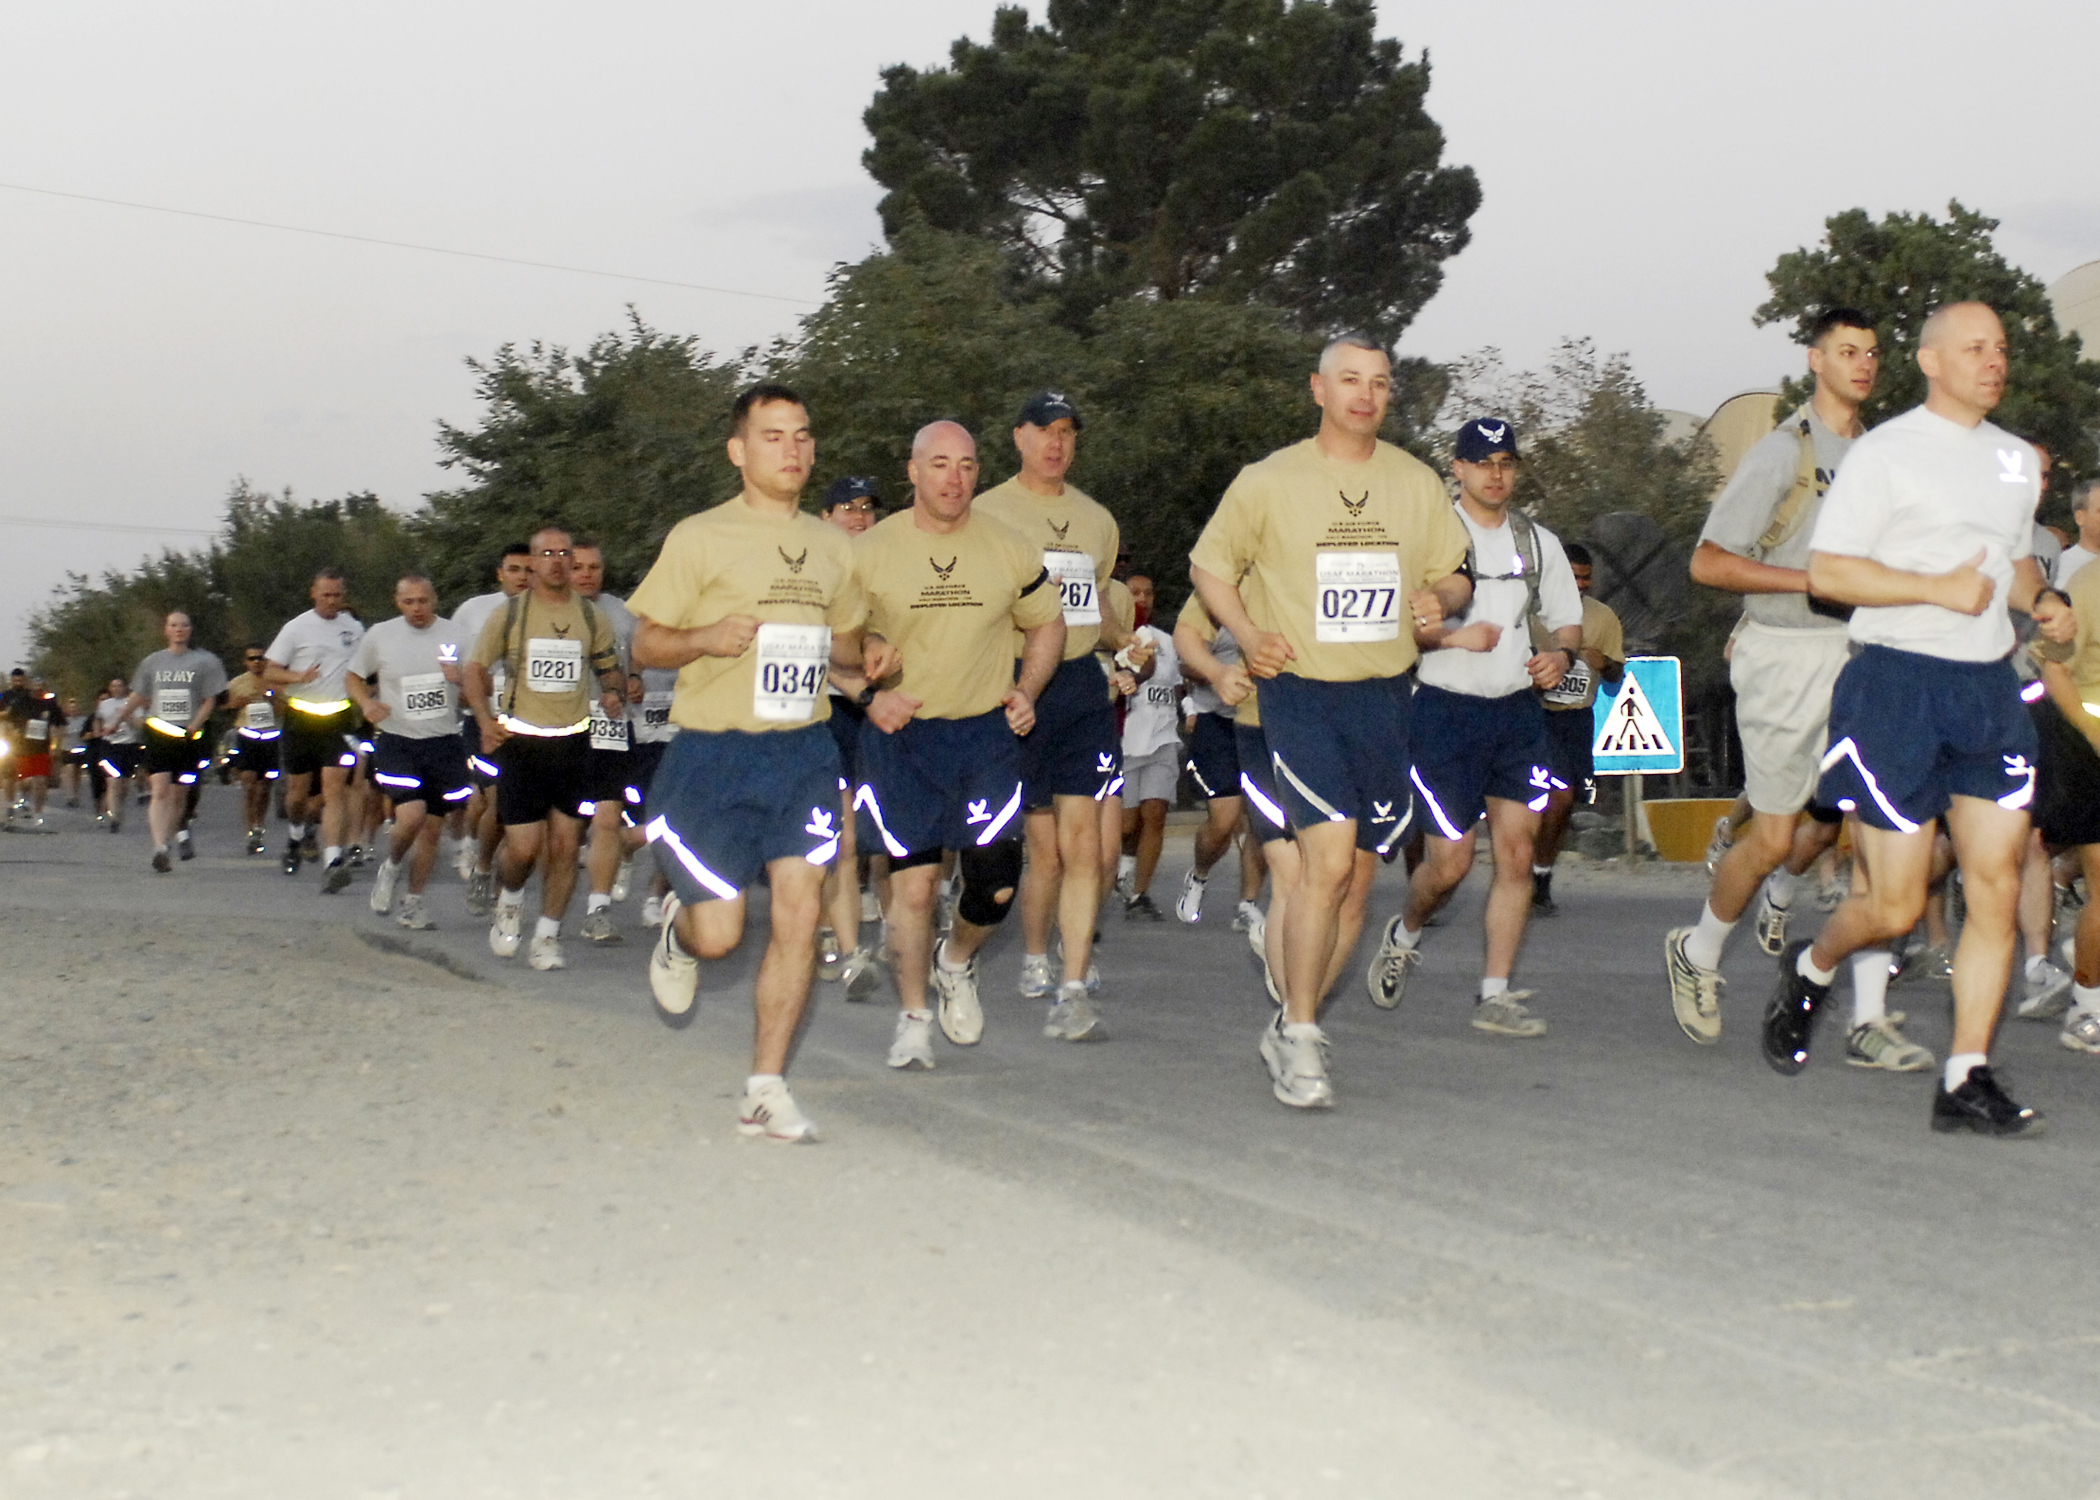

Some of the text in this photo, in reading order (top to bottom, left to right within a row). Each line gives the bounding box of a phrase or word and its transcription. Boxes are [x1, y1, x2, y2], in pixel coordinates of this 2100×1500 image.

[1060, 582, 1092, 607] 267
[1323, 588, 1395, 618] 0277
[155, 670, 195, 683] ARMY
[532, 660, 574, 679] 0281
[1559, 675, 1588, 694] 305
[407, 690, 445, 709] 0385
[590, 719, 627, 738] 0333
